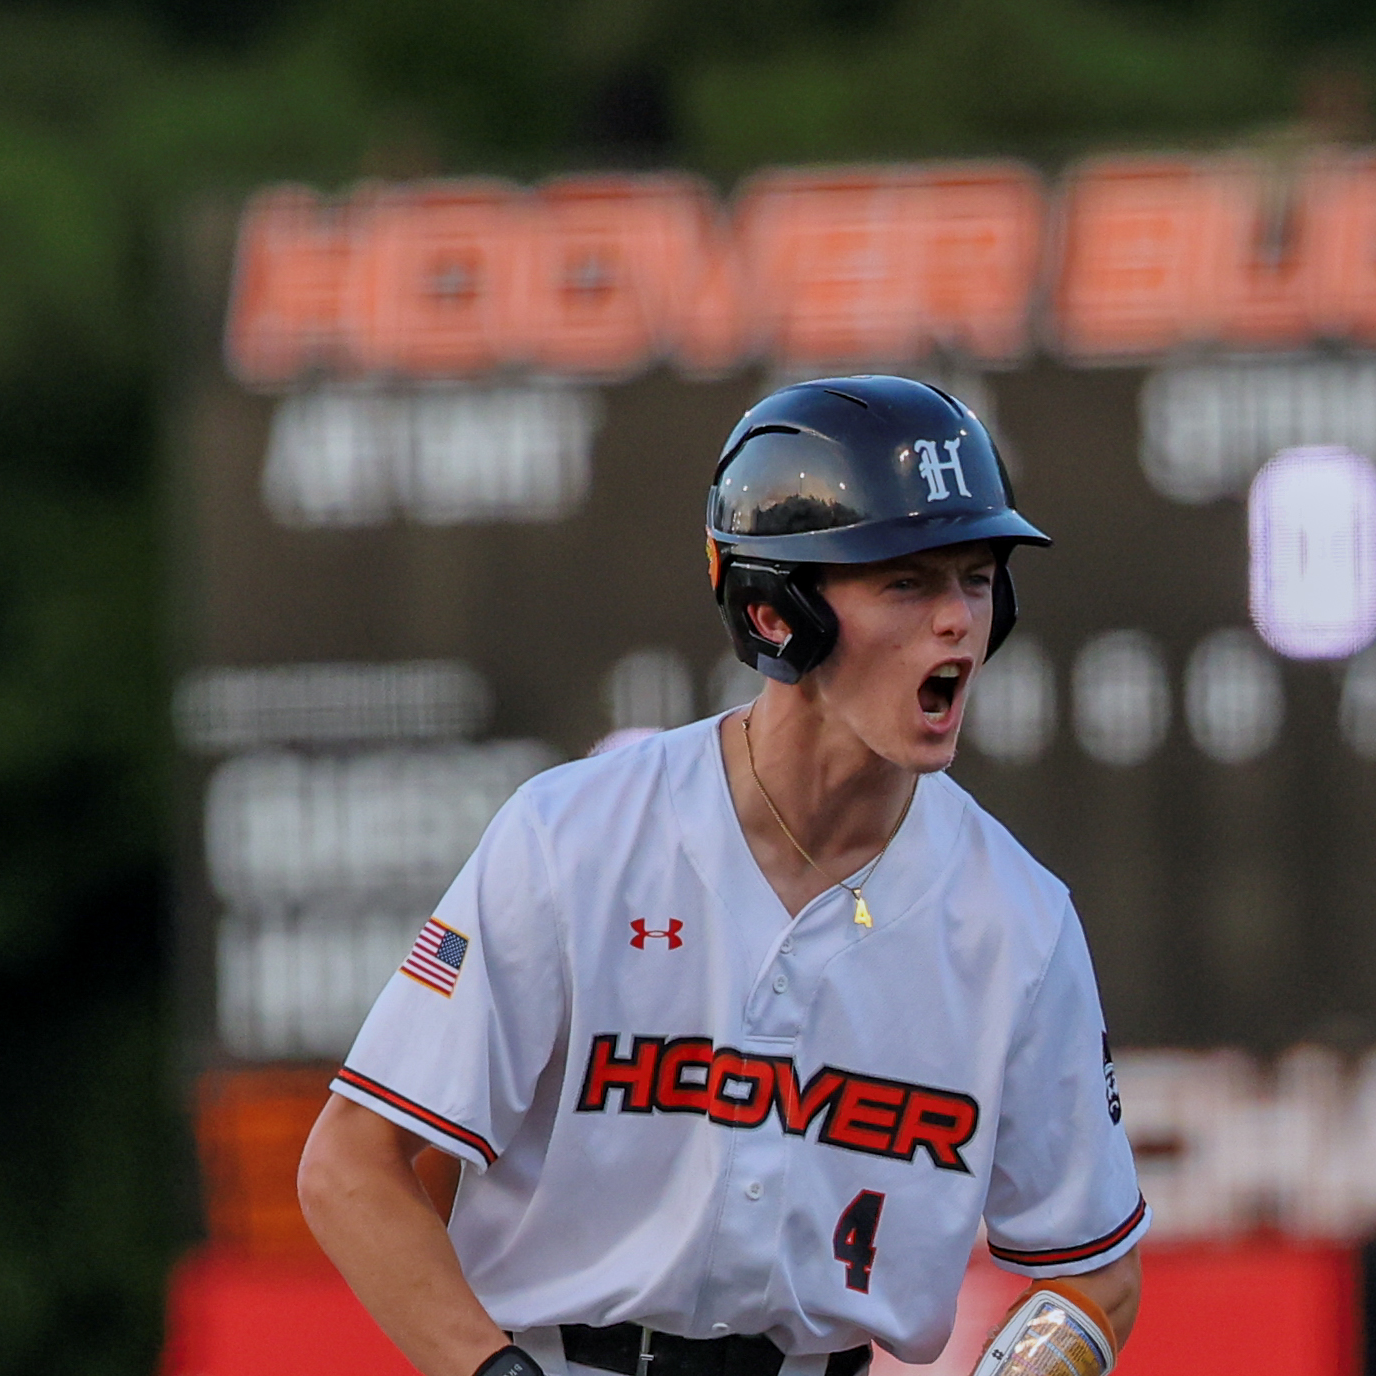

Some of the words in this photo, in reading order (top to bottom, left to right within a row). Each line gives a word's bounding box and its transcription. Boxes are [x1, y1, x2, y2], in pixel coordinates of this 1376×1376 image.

[227, 160, 1045, 388] HOOVER
[914, 437, 972, 502] H
[574, 1033, 979, 1177] HOOVER
[833, 1188, 886, 1294] 4
